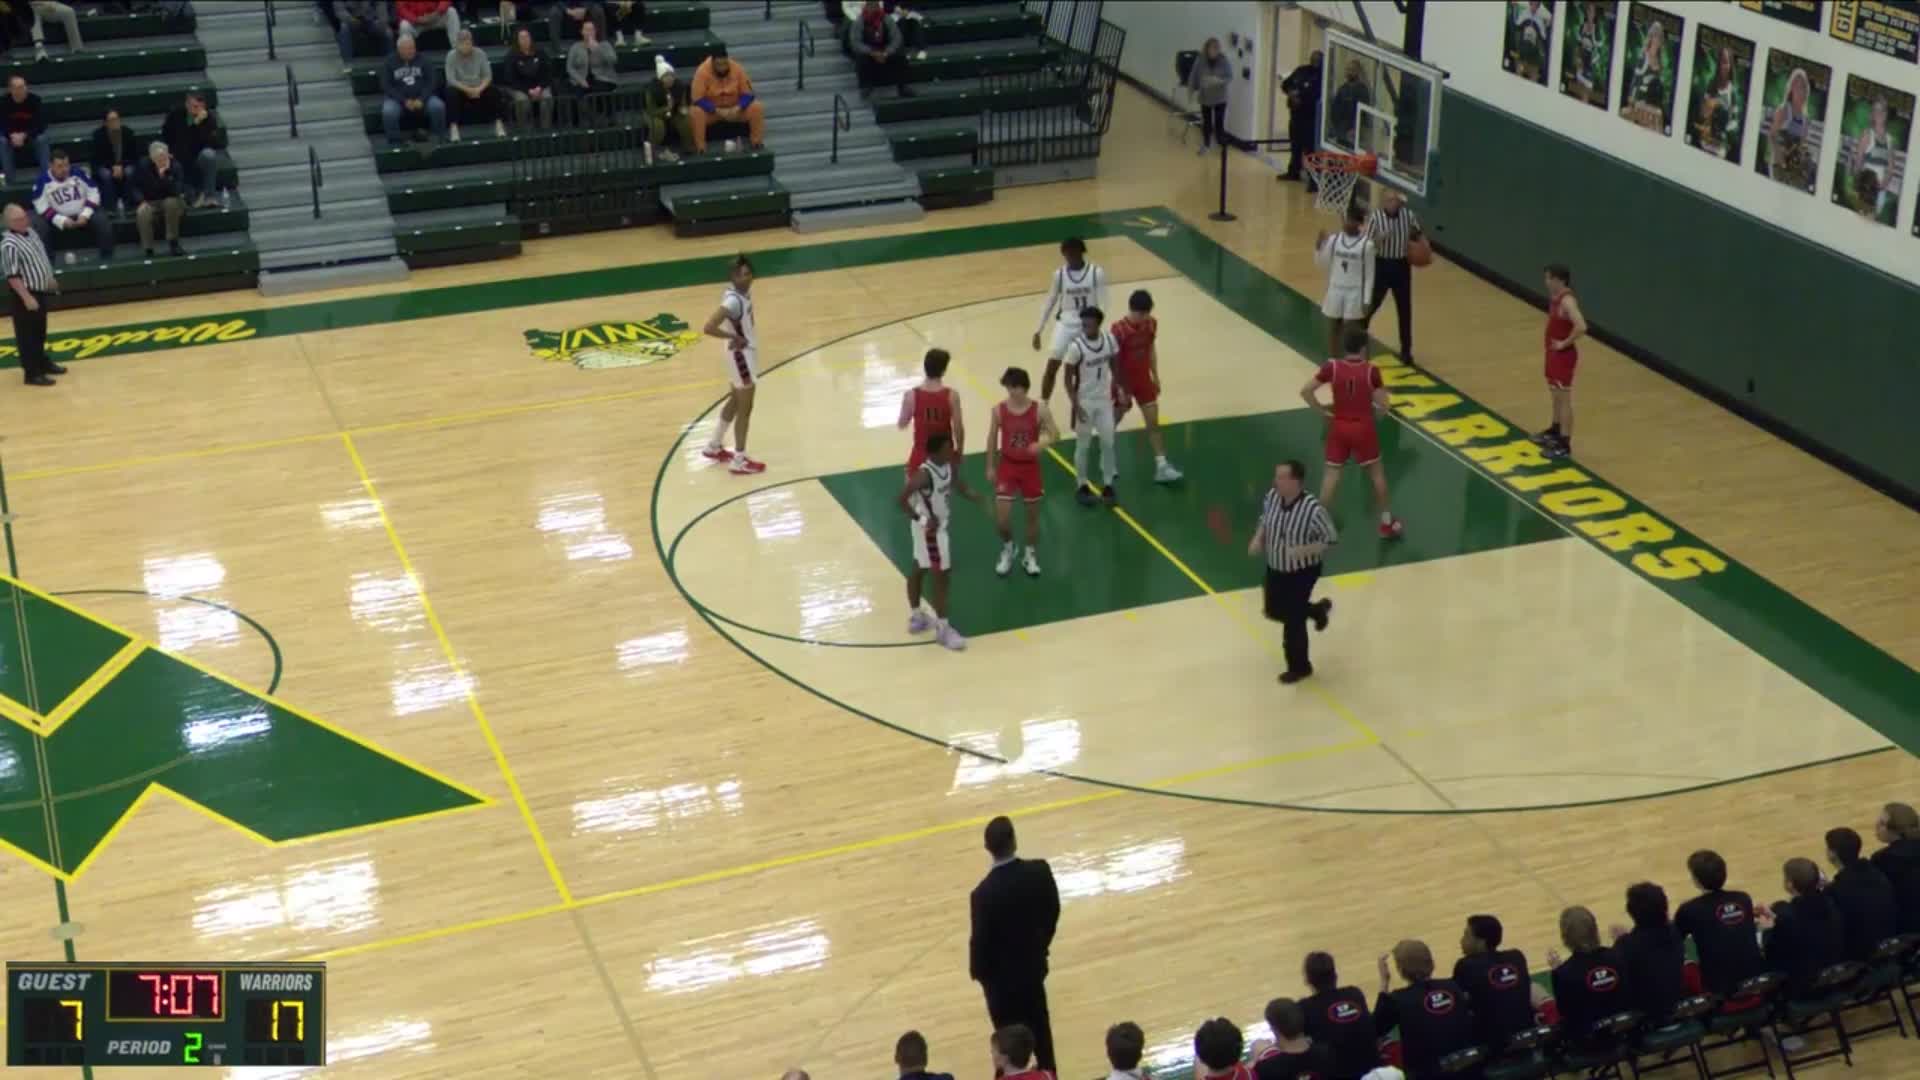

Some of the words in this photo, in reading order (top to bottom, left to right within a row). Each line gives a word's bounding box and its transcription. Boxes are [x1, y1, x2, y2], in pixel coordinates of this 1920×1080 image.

[51, 186, 81, 206] USA
[0, 319, 256, 358] Waubo
[1370, 354, 1728, 580] WARRIORS
